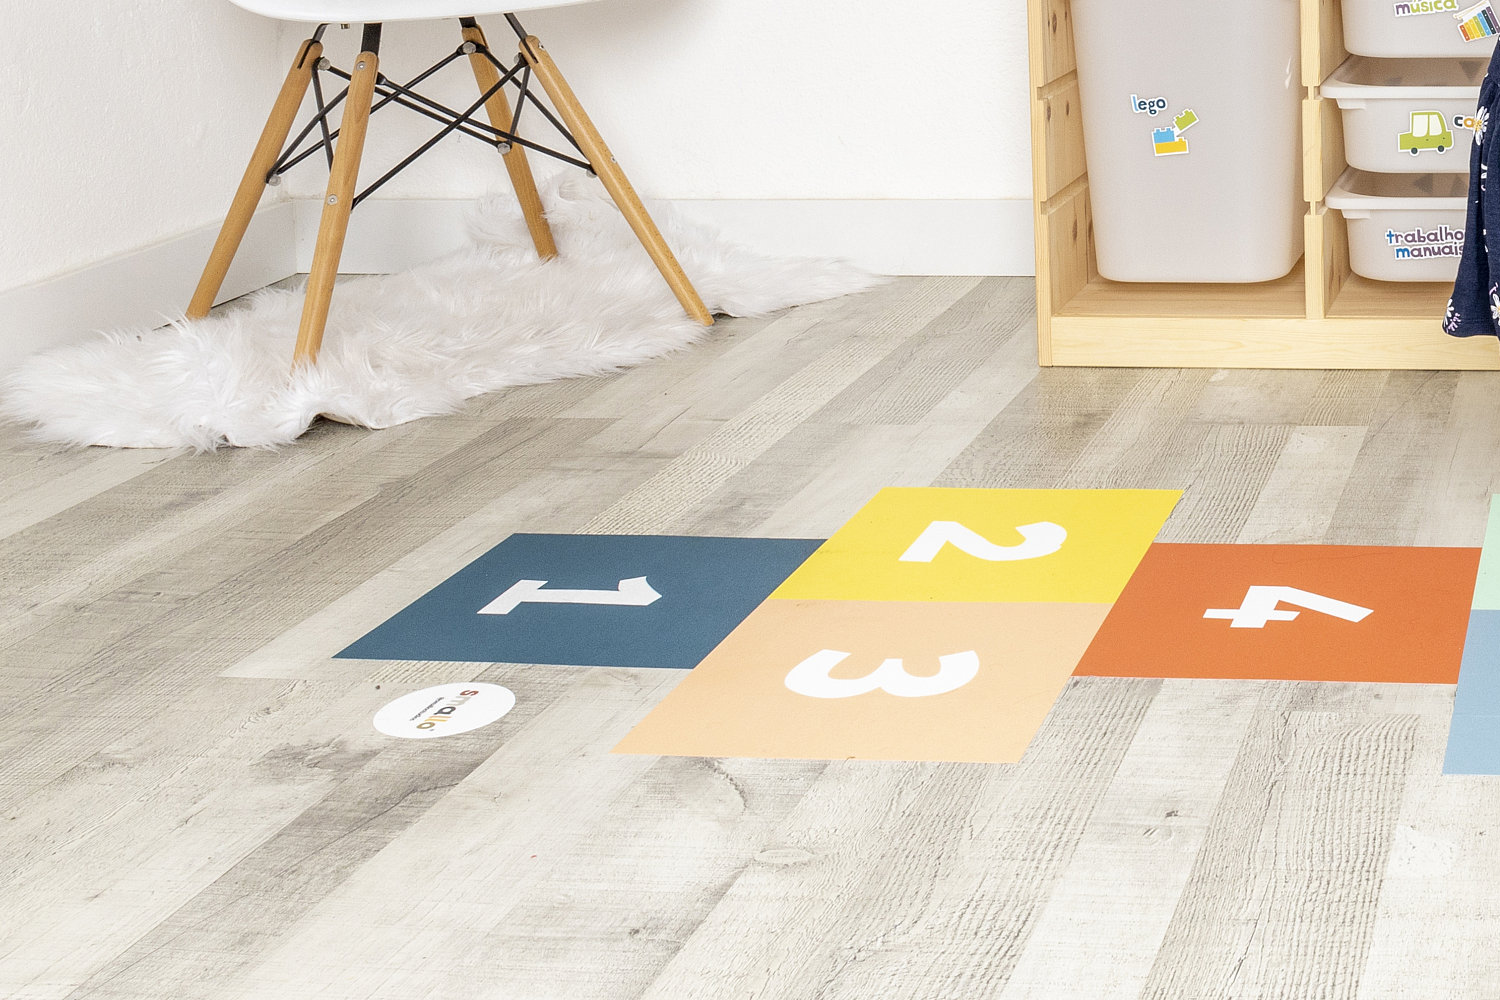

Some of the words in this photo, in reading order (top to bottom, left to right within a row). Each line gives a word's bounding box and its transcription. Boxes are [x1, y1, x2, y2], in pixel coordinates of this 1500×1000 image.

[1132, 95, 1166, 115] lego
[899, 520, 1068, 562] 2
[477, 576, 662, 615] 1
[1203, 585, 1374, 628] 4
[784, 649, 980, 699] 3
[416, 690, 479, 730] smallo
